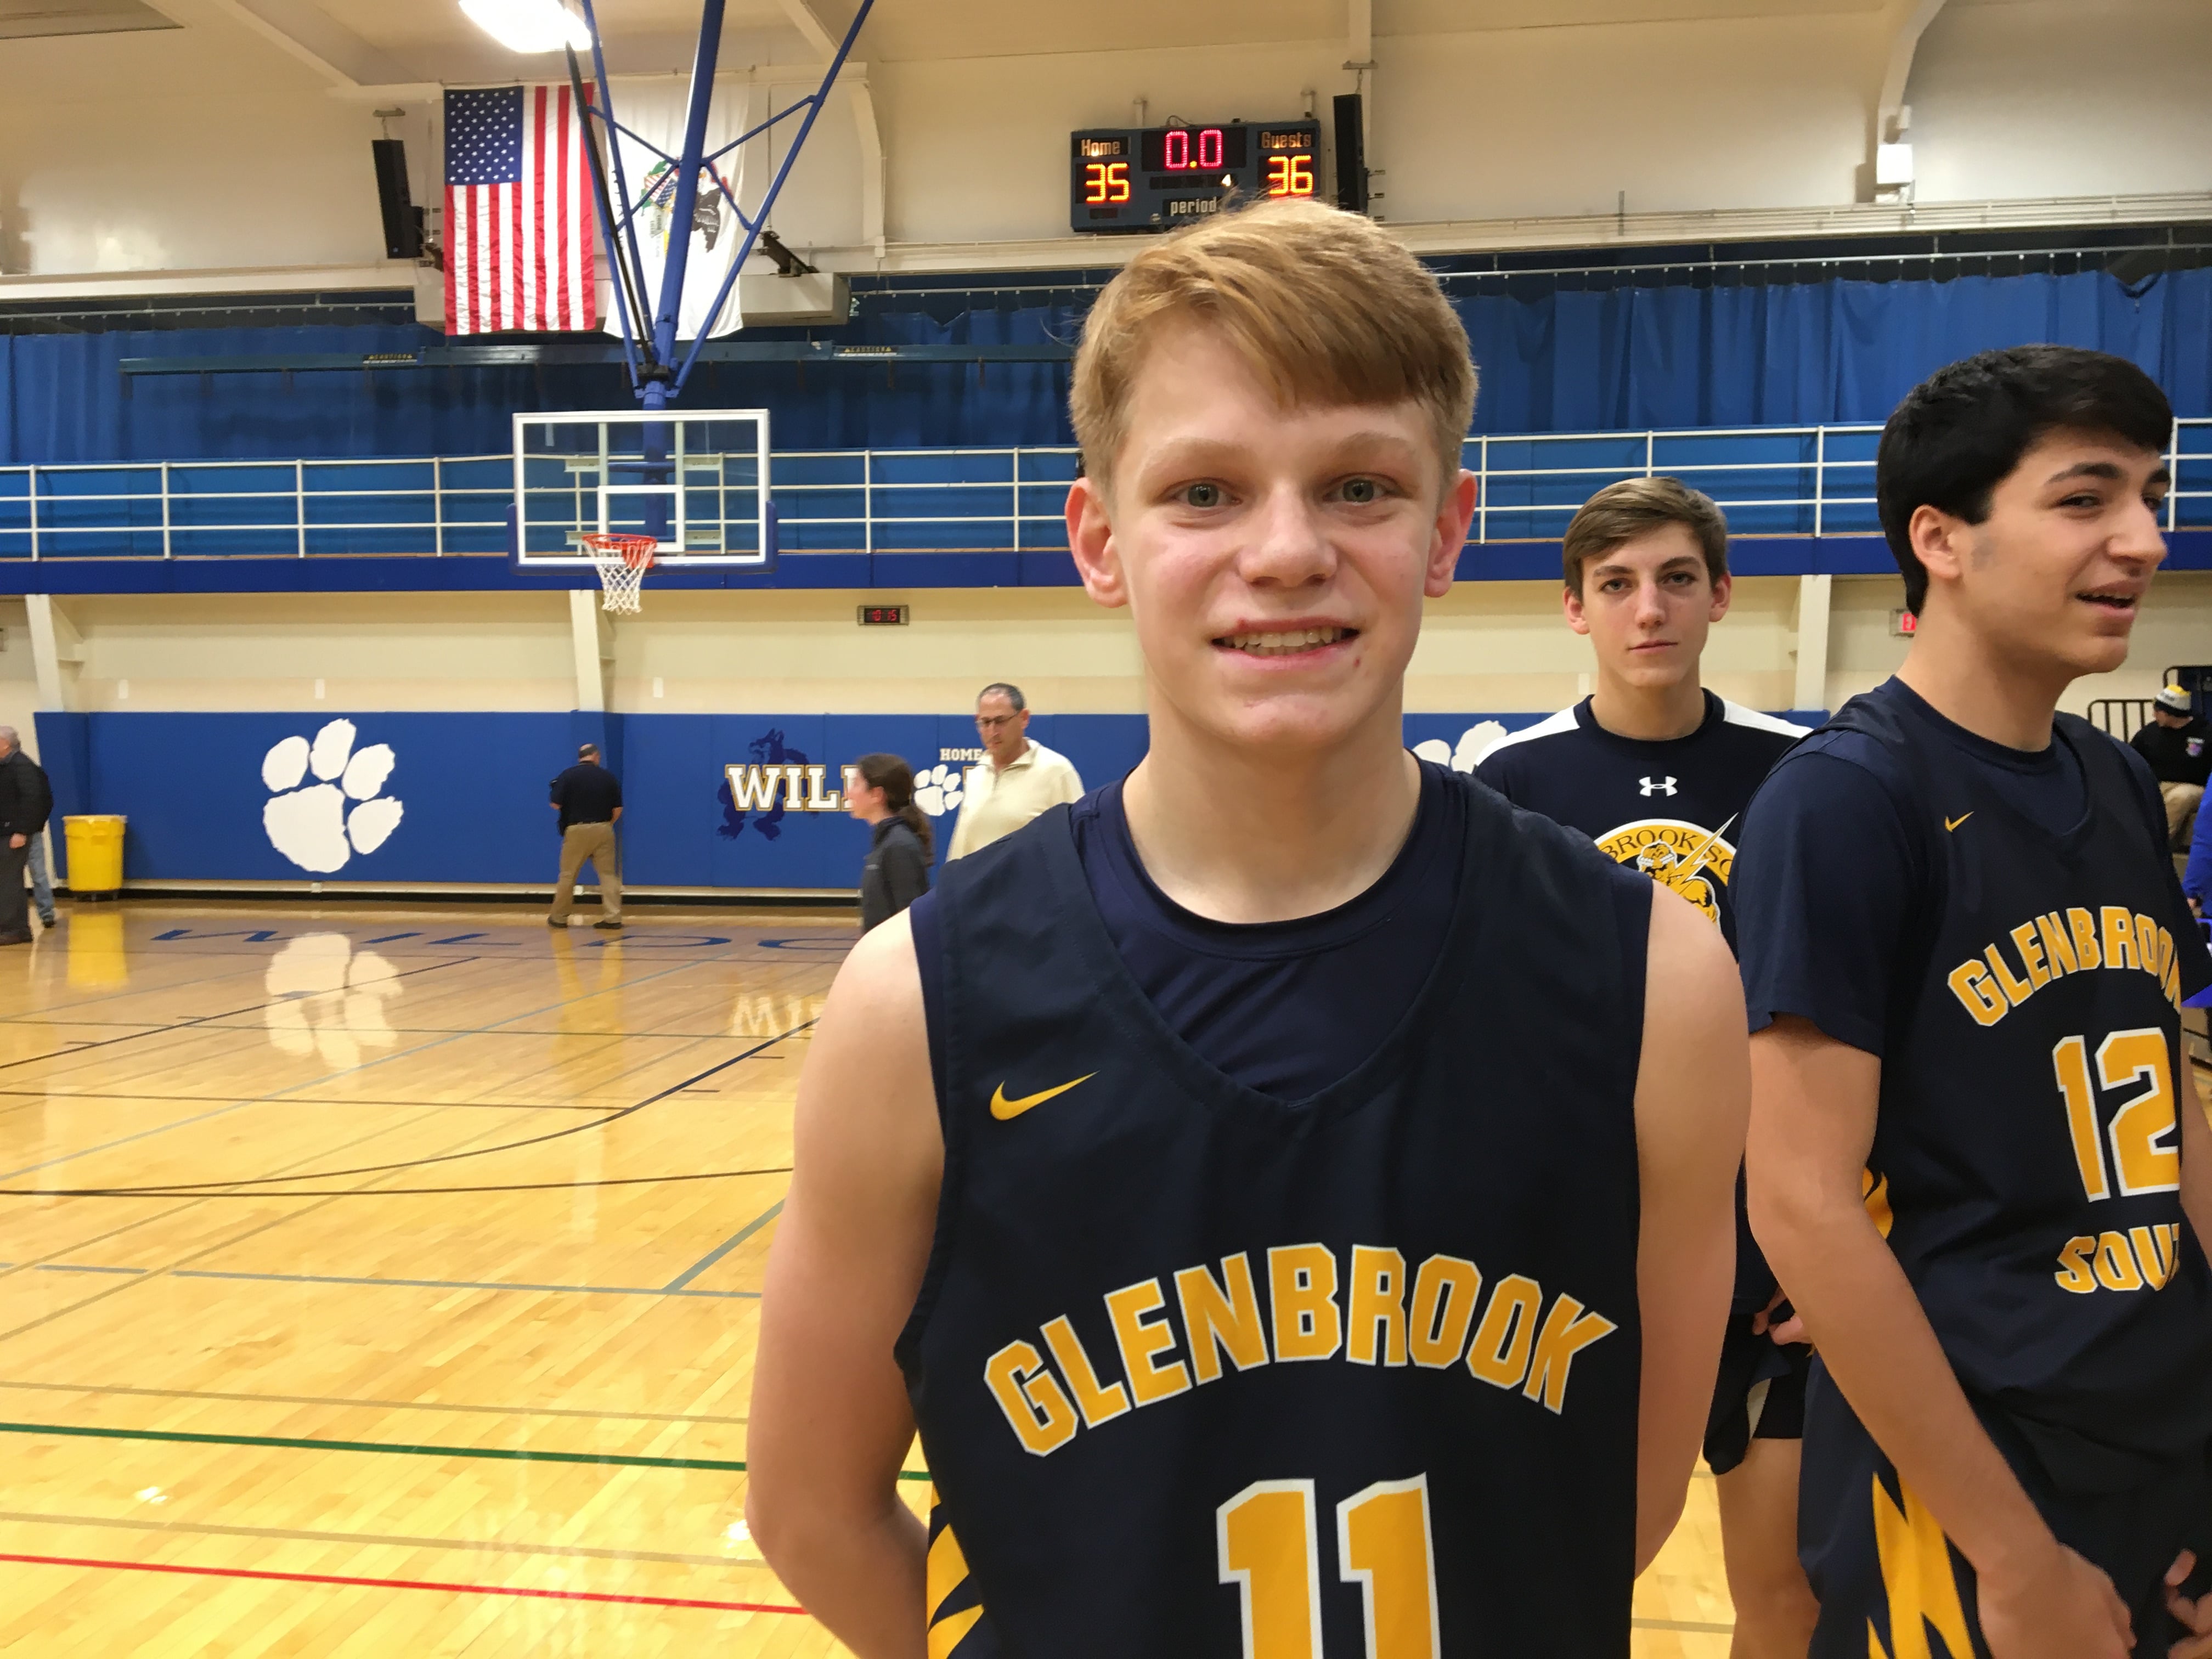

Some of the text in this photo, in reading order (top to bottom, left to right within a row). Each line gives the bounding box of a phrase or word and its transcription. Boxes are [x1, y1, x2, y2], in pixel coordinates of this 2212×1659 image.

[1081, 139, 1121, 156] Home
[1165, 129, 1222, 168] 0.0
[1261, 132, 1312, 148] Guests
[1086, 163, 1129, 201] 35
[1267, 155, 1313, 195] 36
[1170, 197, 1217, 216] period
[940, 748, 983, 761] HOME
[2052, 1027, 2180, 1203] 12
[984, 1243, 1617, 1457] GLENBROOK
[1216, 1471, 1441, 1659] 11
